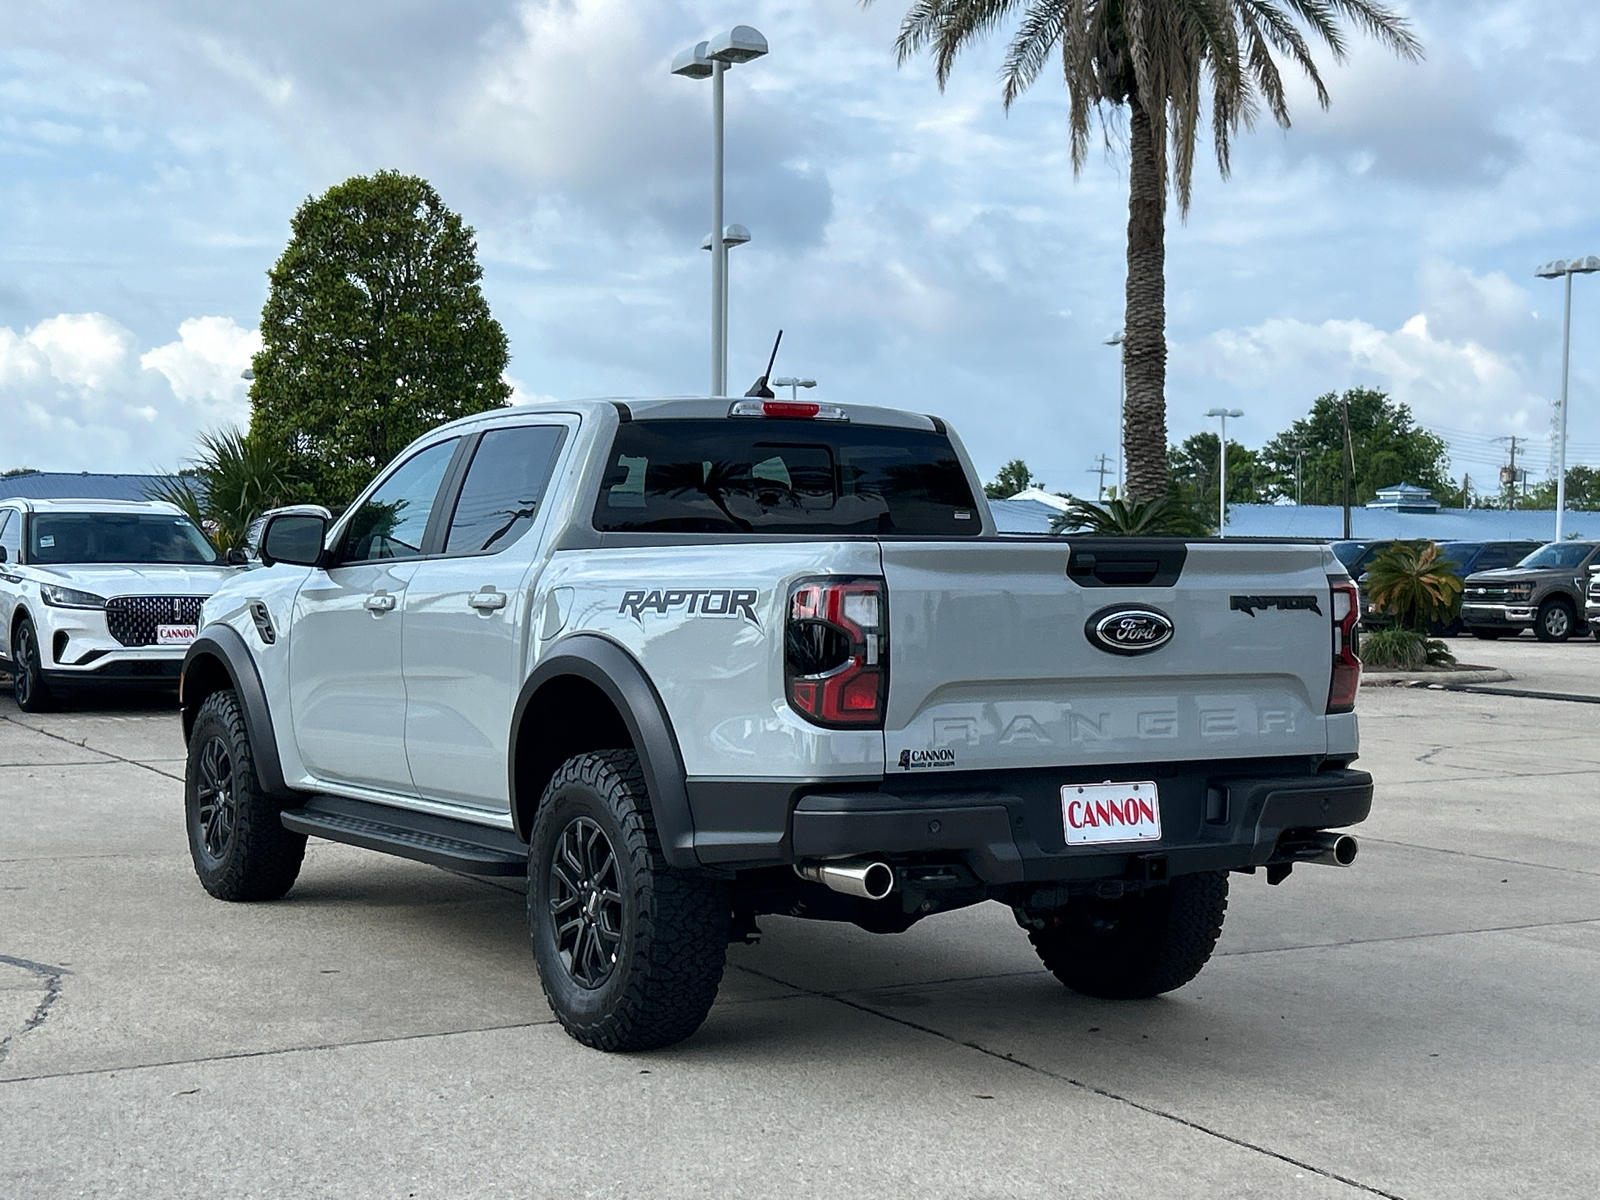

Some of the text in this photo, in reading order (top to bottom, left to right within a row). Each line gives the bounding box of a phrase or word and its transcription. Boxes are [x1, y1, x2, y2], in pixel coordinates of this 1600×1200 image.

[617, 589, 763, 628] RAPTOR
[1230, 595, 1322, 617] RAPTOR
[160, 628, 195, 639] CANNON
[1116, 618, 1157, 640] Ford
[932, 708, 1296, 747] RANGER
[911, 749, 955, 762] CANNON
[1068, 797, 1155, 828] CANNON
